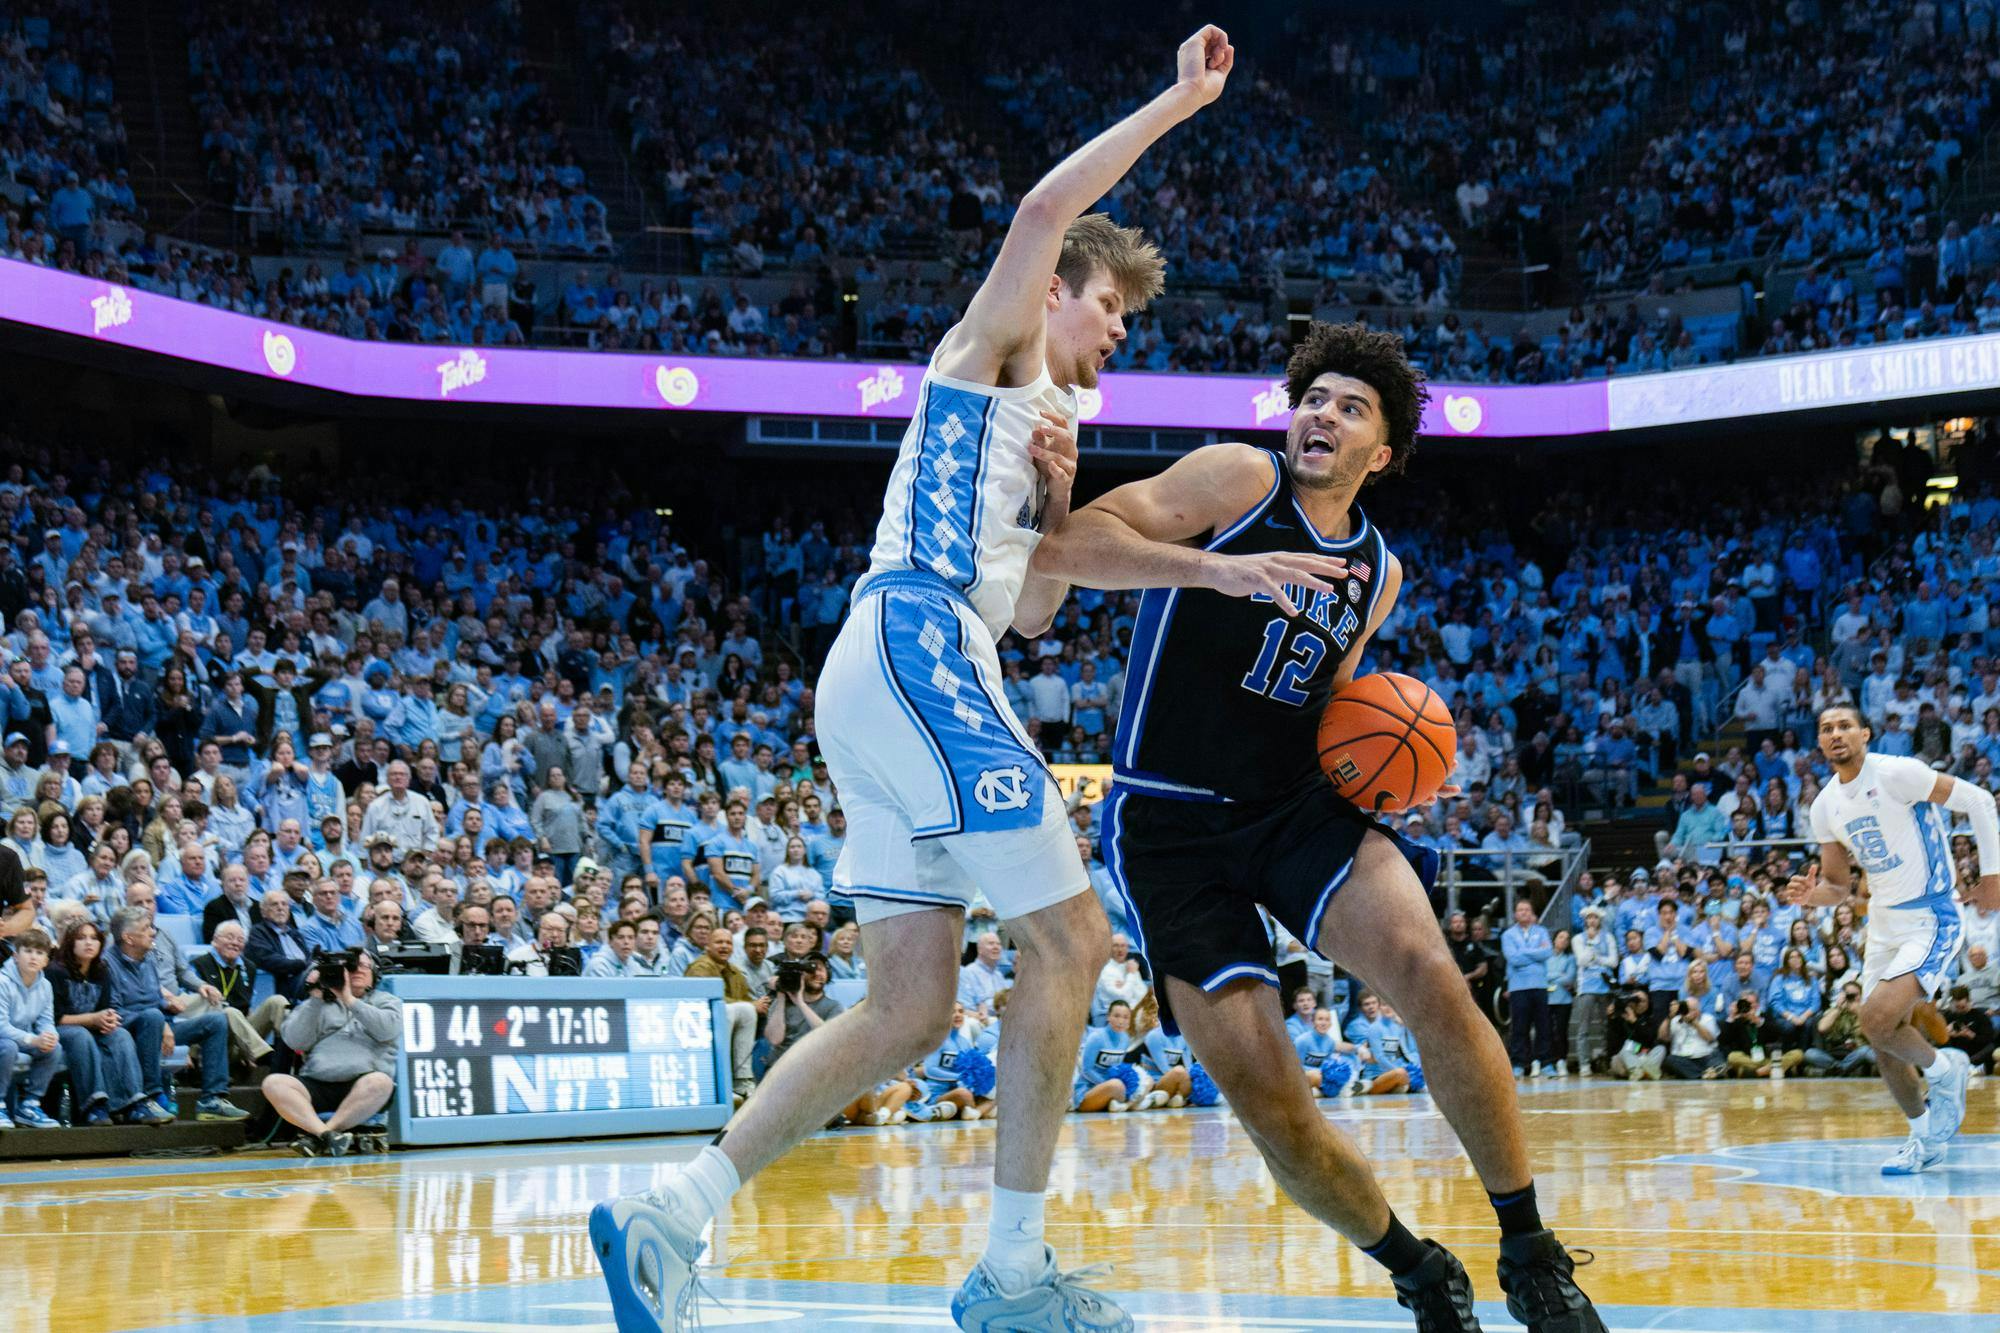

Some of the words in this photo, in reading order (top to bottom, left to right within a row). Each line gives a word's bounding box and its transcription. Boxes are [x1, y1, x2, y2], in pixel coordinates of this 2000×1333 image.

[1780, 361, 1834, 402] DEAN
[1871, 349, 1942, 392] SMITH
[1241, 618, 1326, 707] 12
[1850, 830, 1889, 861] 15
[402, 1003, 435, 1053] D
[447, 1005, 482, 1047] 44
[547, 1007, 609, 1045] 17:16
[414, 1058, 455, 1088] FLS:
[457, 1058, 471, 1088] 0
[413, 1088, 458, 1117] TOL:
[459, 1087, 474, 1115] 3
[607, 1080, 621, 1109] 3
[688, 1080, 700, 1106] 3
